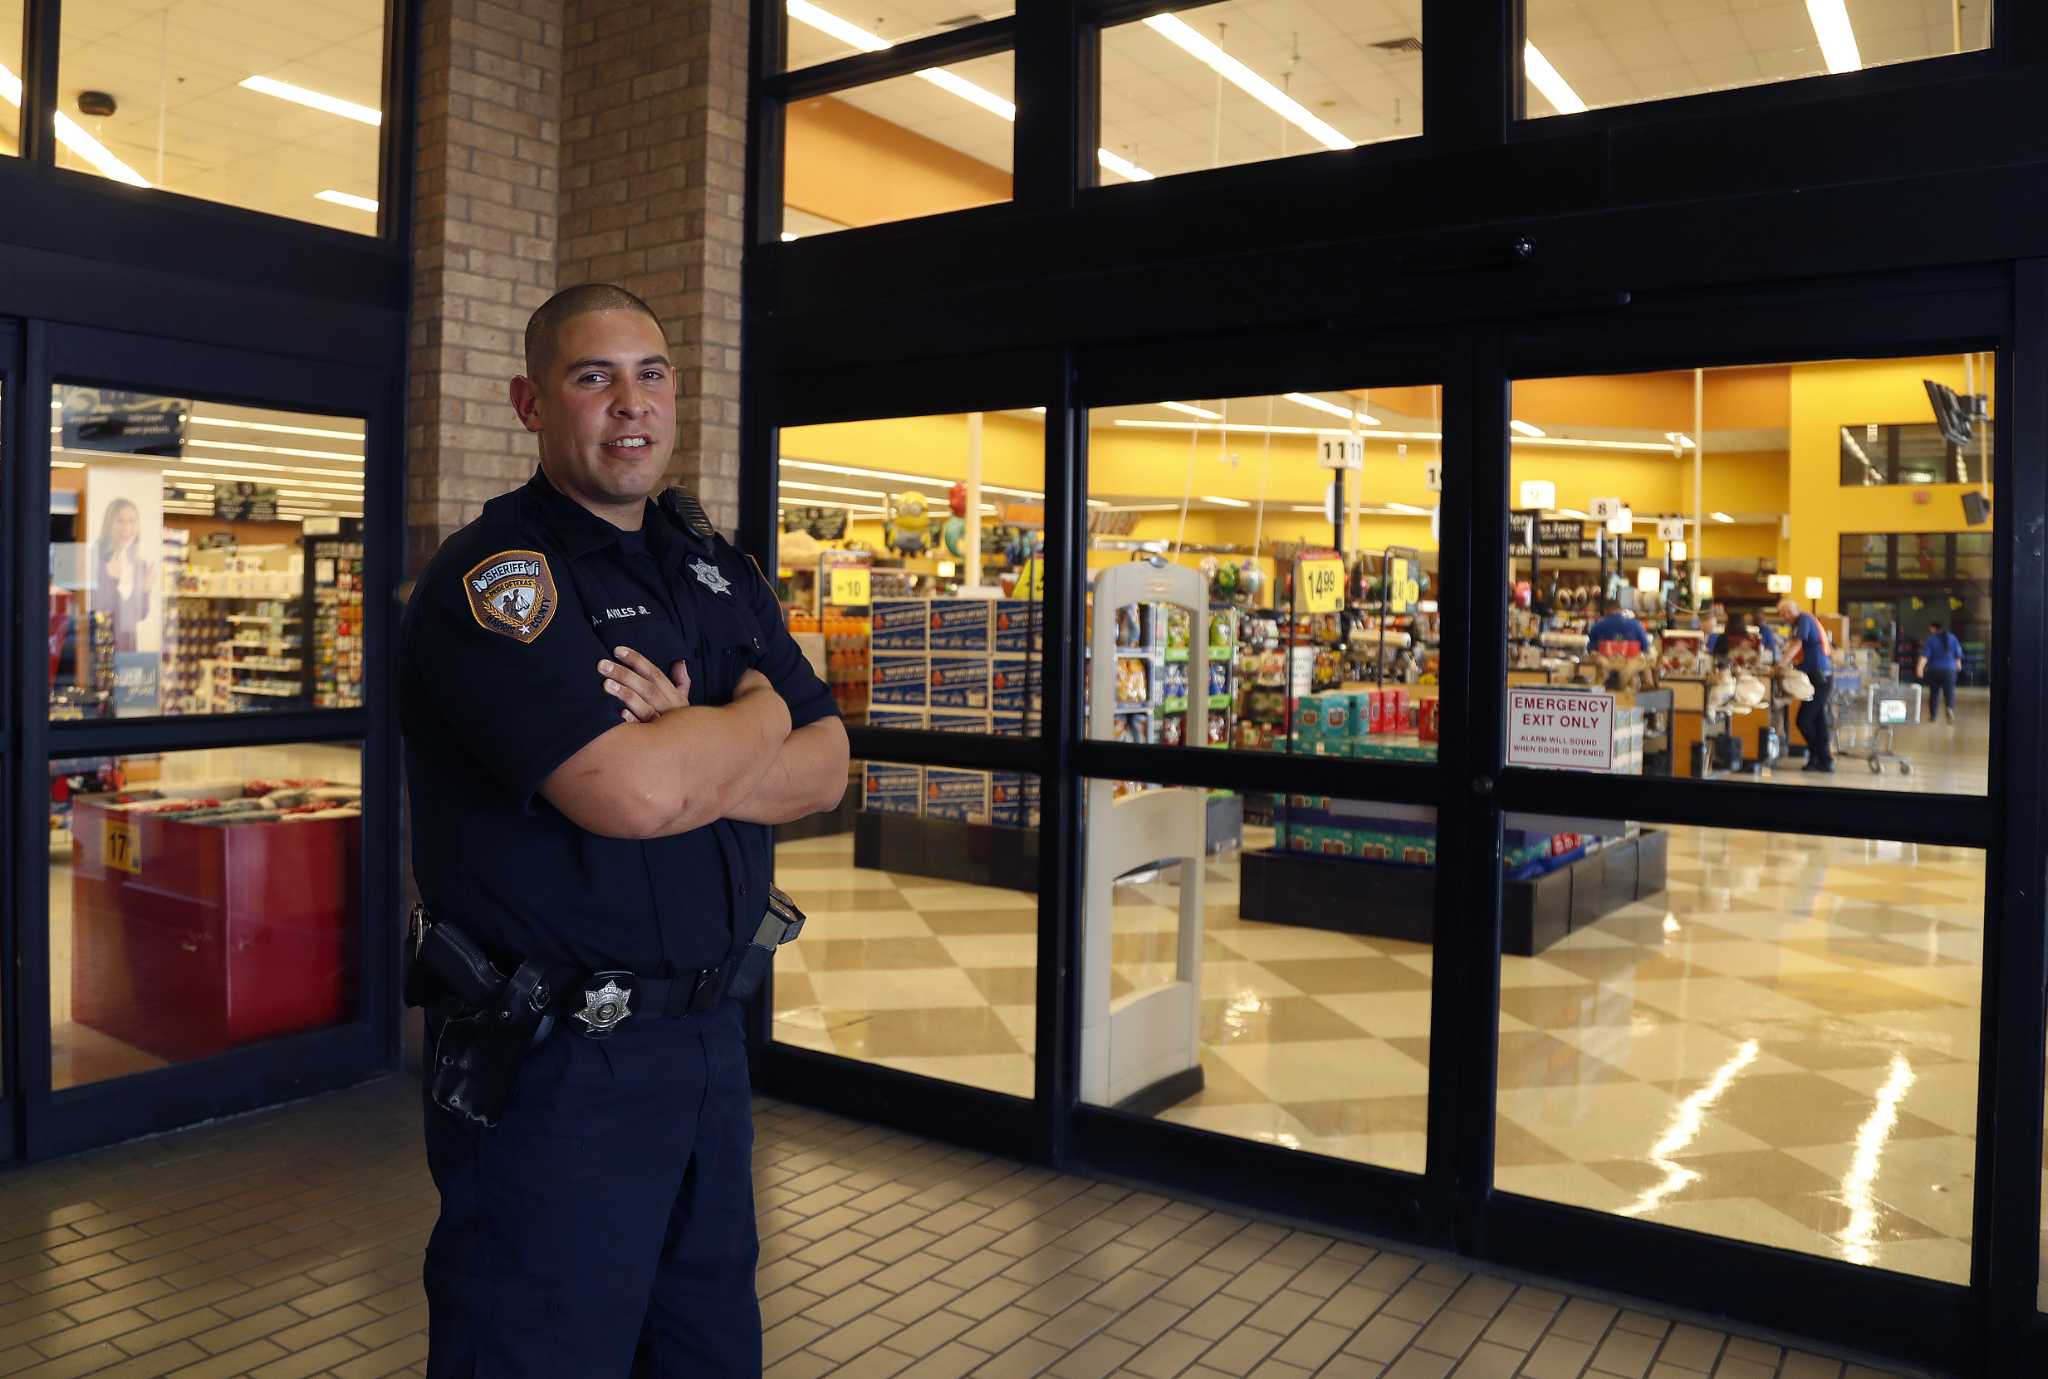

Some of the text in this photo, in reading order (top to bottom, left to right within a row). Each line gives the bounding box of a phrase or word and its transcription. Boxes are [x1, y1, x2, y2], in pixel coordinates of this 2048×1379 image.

[1322, 442, 1344, 459] 11
[1429, 468, 1441, 484] 1
[1598, 503, 1607, 515] 8
[485, 562, 526, 582] SHERIFF
[606, 607, 637, 619] AVILES
[1514, 696, 1608, 713] EMERGENCY
[1522, 713, 1599, 729] EXIT ONLY
[1521, 735, 1597, 746] ALARM WILL SOUND
[1513, 744, 1536, 753] WHEN
[1538, 746, 1560, 754] DOOR
[1572, 749, 1604, 757] OPENED
[111, 832, 127, 863] 17
